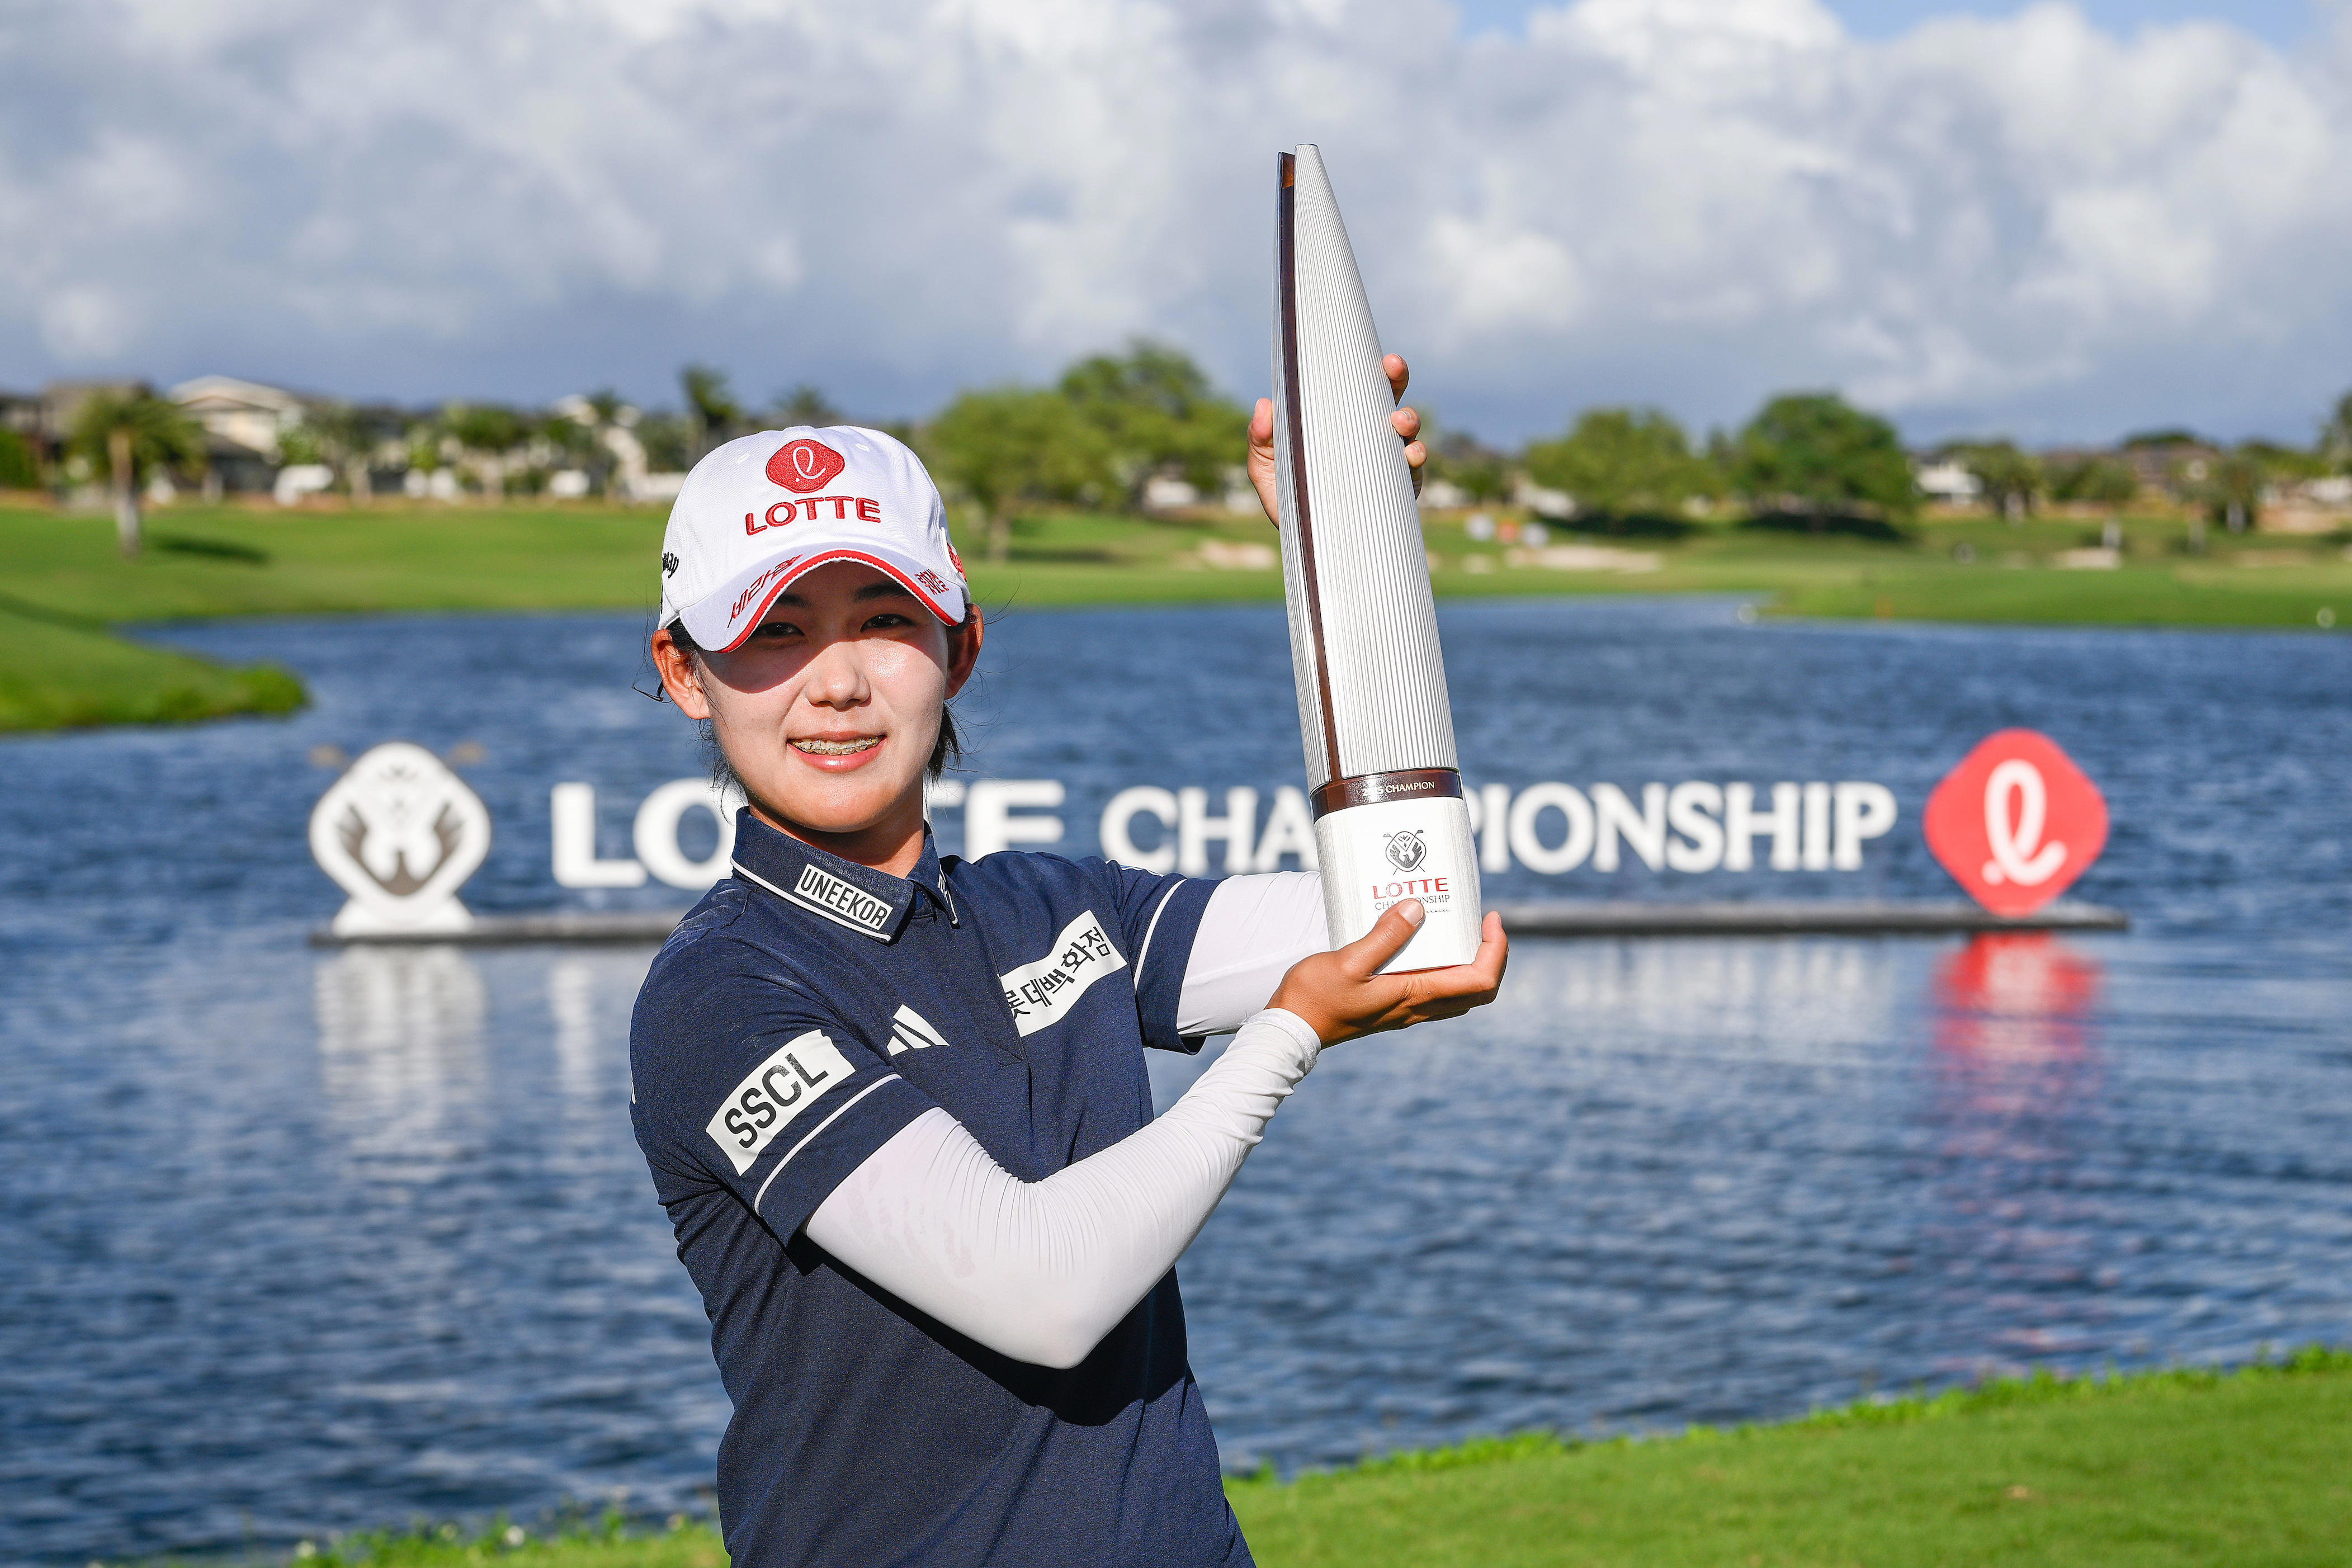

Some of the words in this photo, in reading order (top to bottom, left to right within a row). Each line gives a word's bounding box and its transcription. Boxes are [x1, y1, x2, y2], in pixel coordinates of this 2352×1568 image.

[745, 496, 881, 536] LOTTE
[1385, 781, 1435, 794] CHAMPION
[551, 780, 1066, 890] LOE
[1100, 780, 1897, 875] CHAIONSHIP
[801, 867, 889, 928] UNEEKOR
[1372, 877, 1448, 899] LOTTE
[1375, 895, 1450, 910] CHAONSHIP
[1005, 926, 1111, 1020] 롯데백화점
[725, 1053, 829, 1149] SSCL
